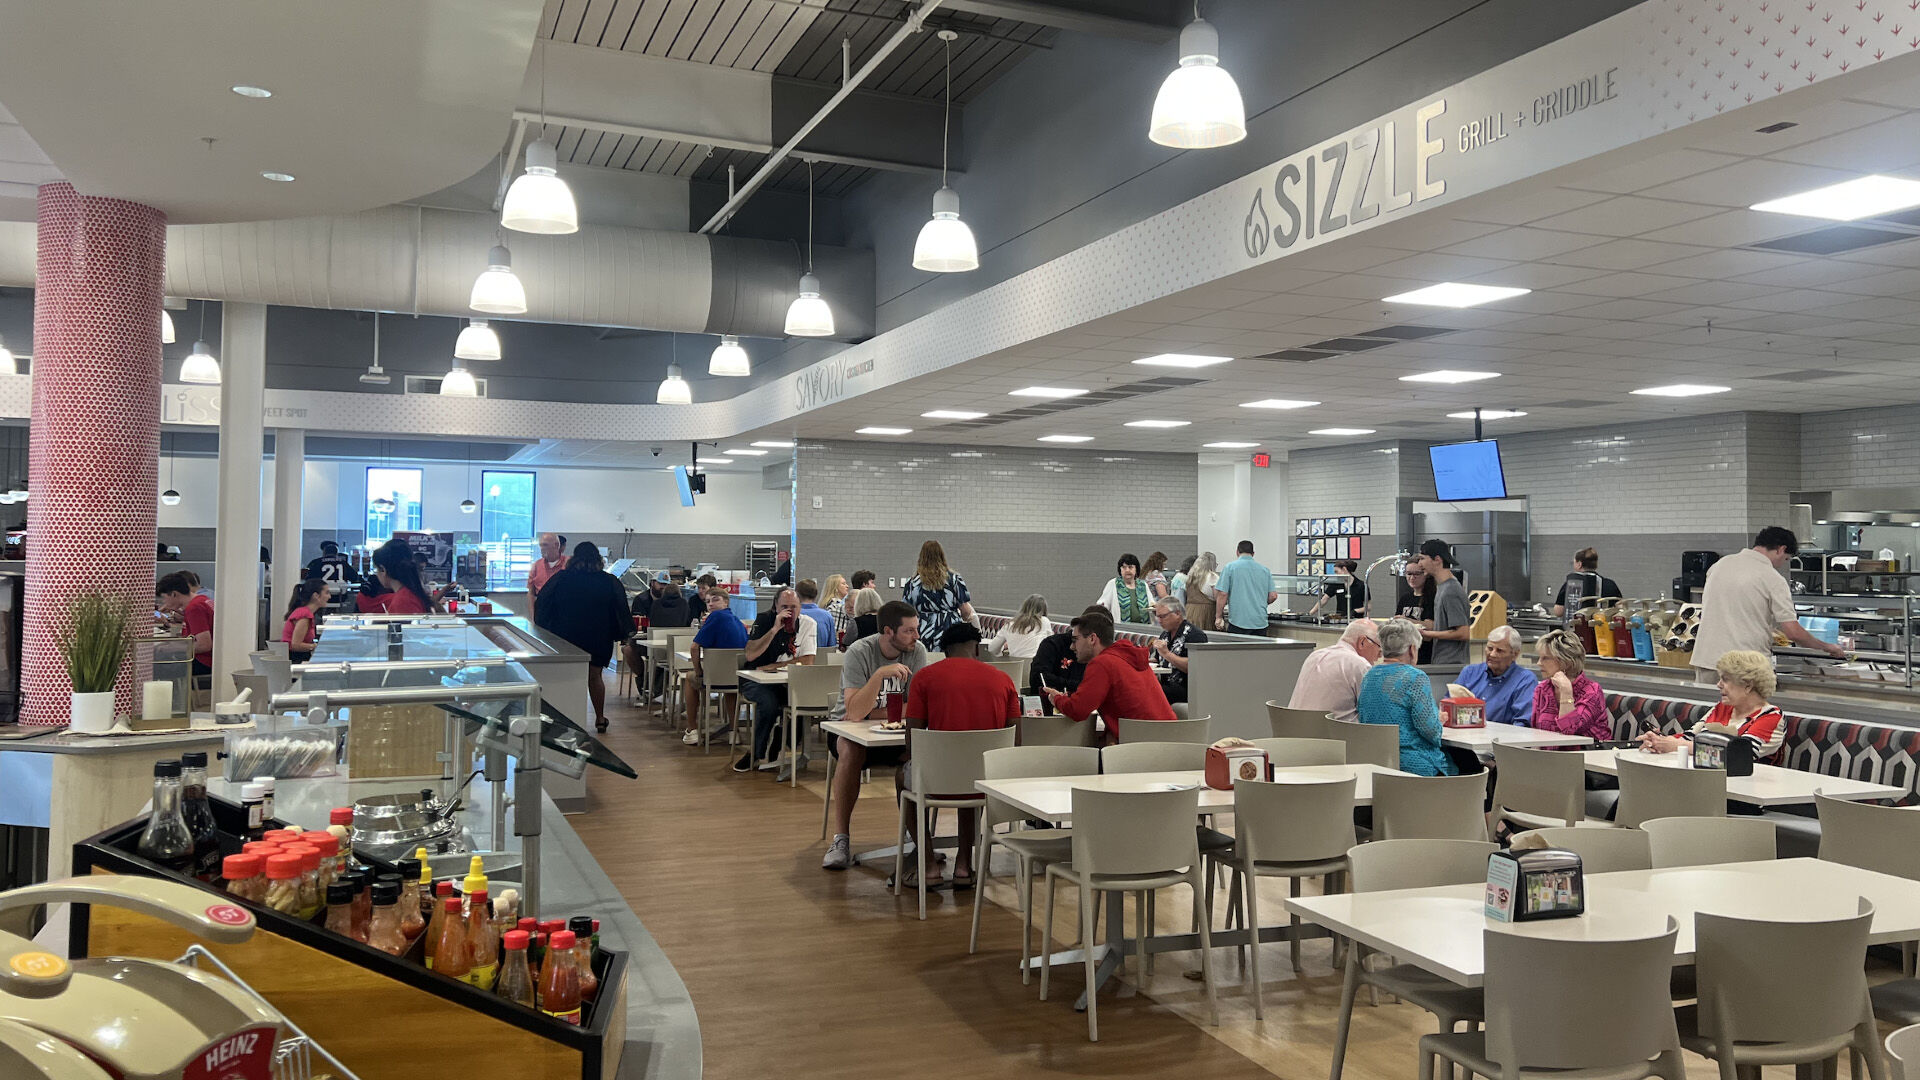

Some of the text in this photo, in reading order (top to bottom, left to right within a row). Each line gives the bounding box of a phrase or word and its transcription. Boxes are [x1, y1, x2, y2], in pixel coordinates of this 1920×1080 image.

[1458, 66, 1619, 153] GRILL + GRIDDLE
[1273, 98, 1447, 248] SIZZLE
[796, 355, 847, 411] SAVORY
[264, 407, 308, 418] EET SPOT
[321, 564, 344, 583] 21
[218, 908, 239, 920] 57
[205, 1033, 259, 1072] HEINZ
